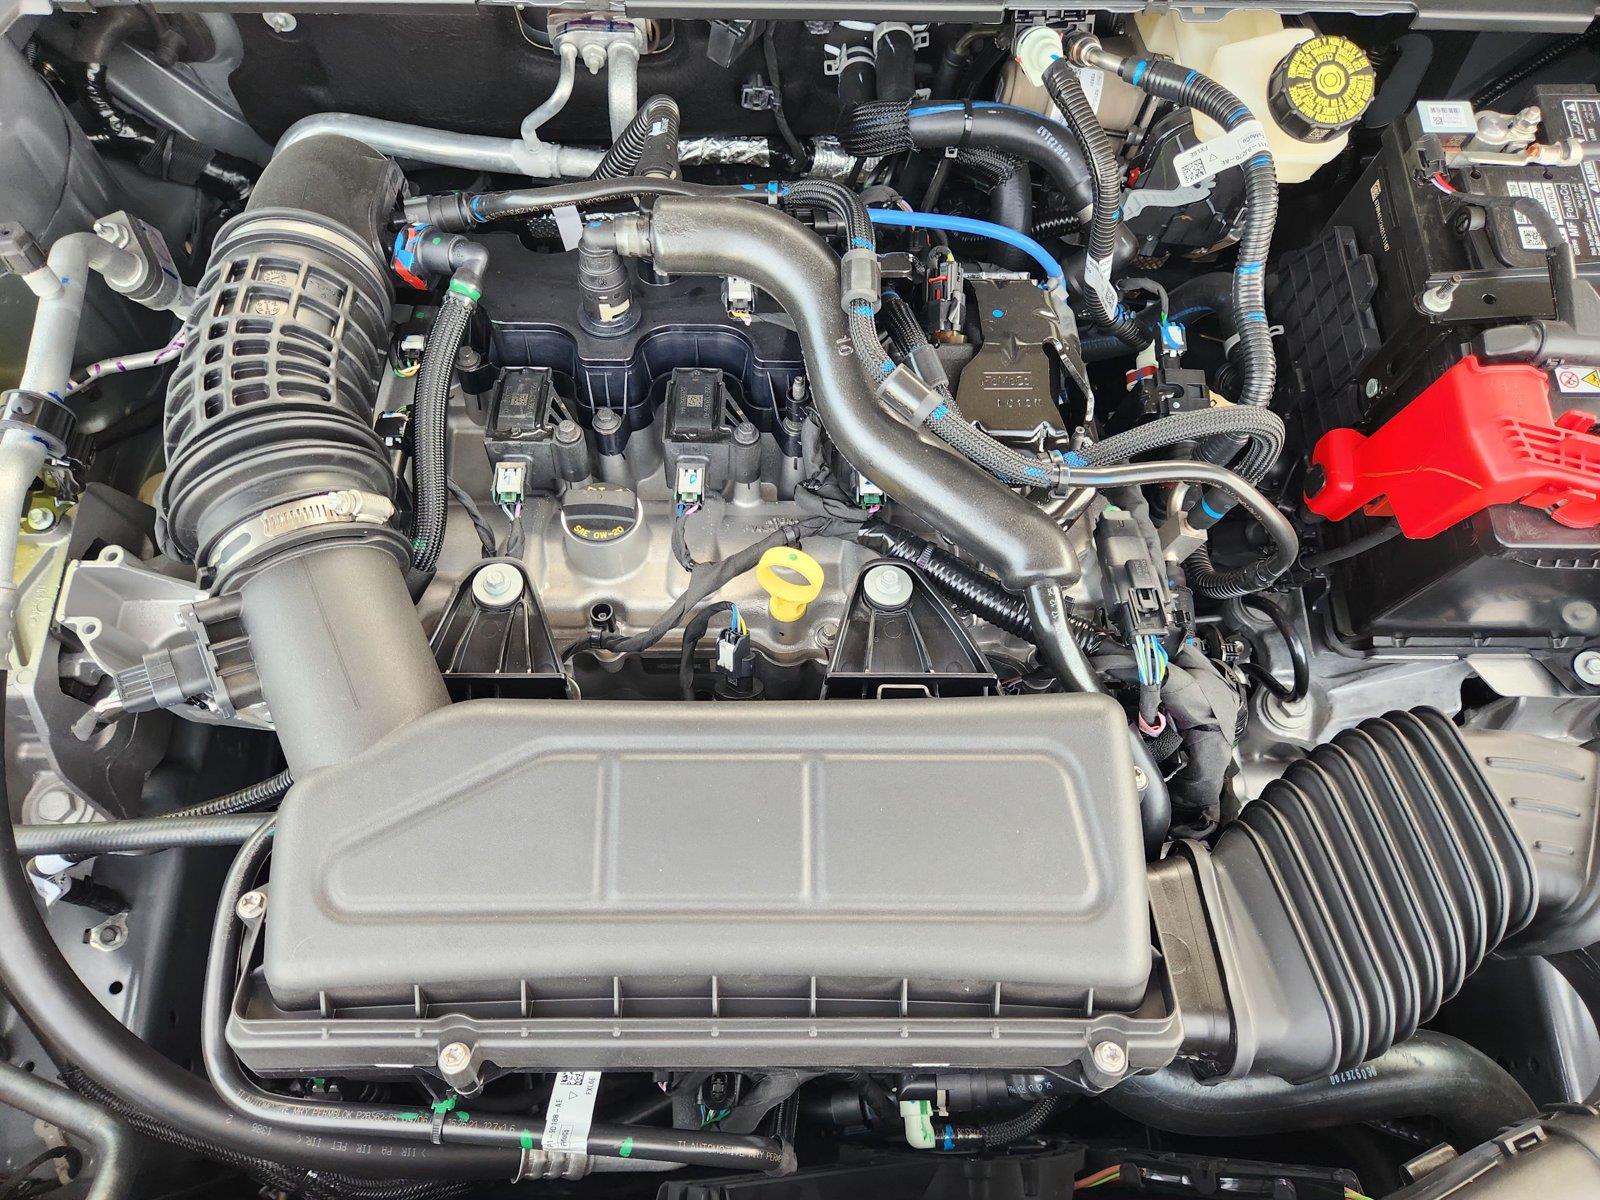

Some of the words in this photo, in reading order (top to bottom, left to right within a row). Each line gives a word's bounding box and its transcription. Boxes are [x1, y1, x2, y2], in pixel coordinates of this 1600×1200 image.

[1560, 184, 1575, 218] FoMoCo
[1567, 222, 1579, 236] MF
[574, 526, 590, 538] SAE
[594, 526, 624, 538] 0W-20
